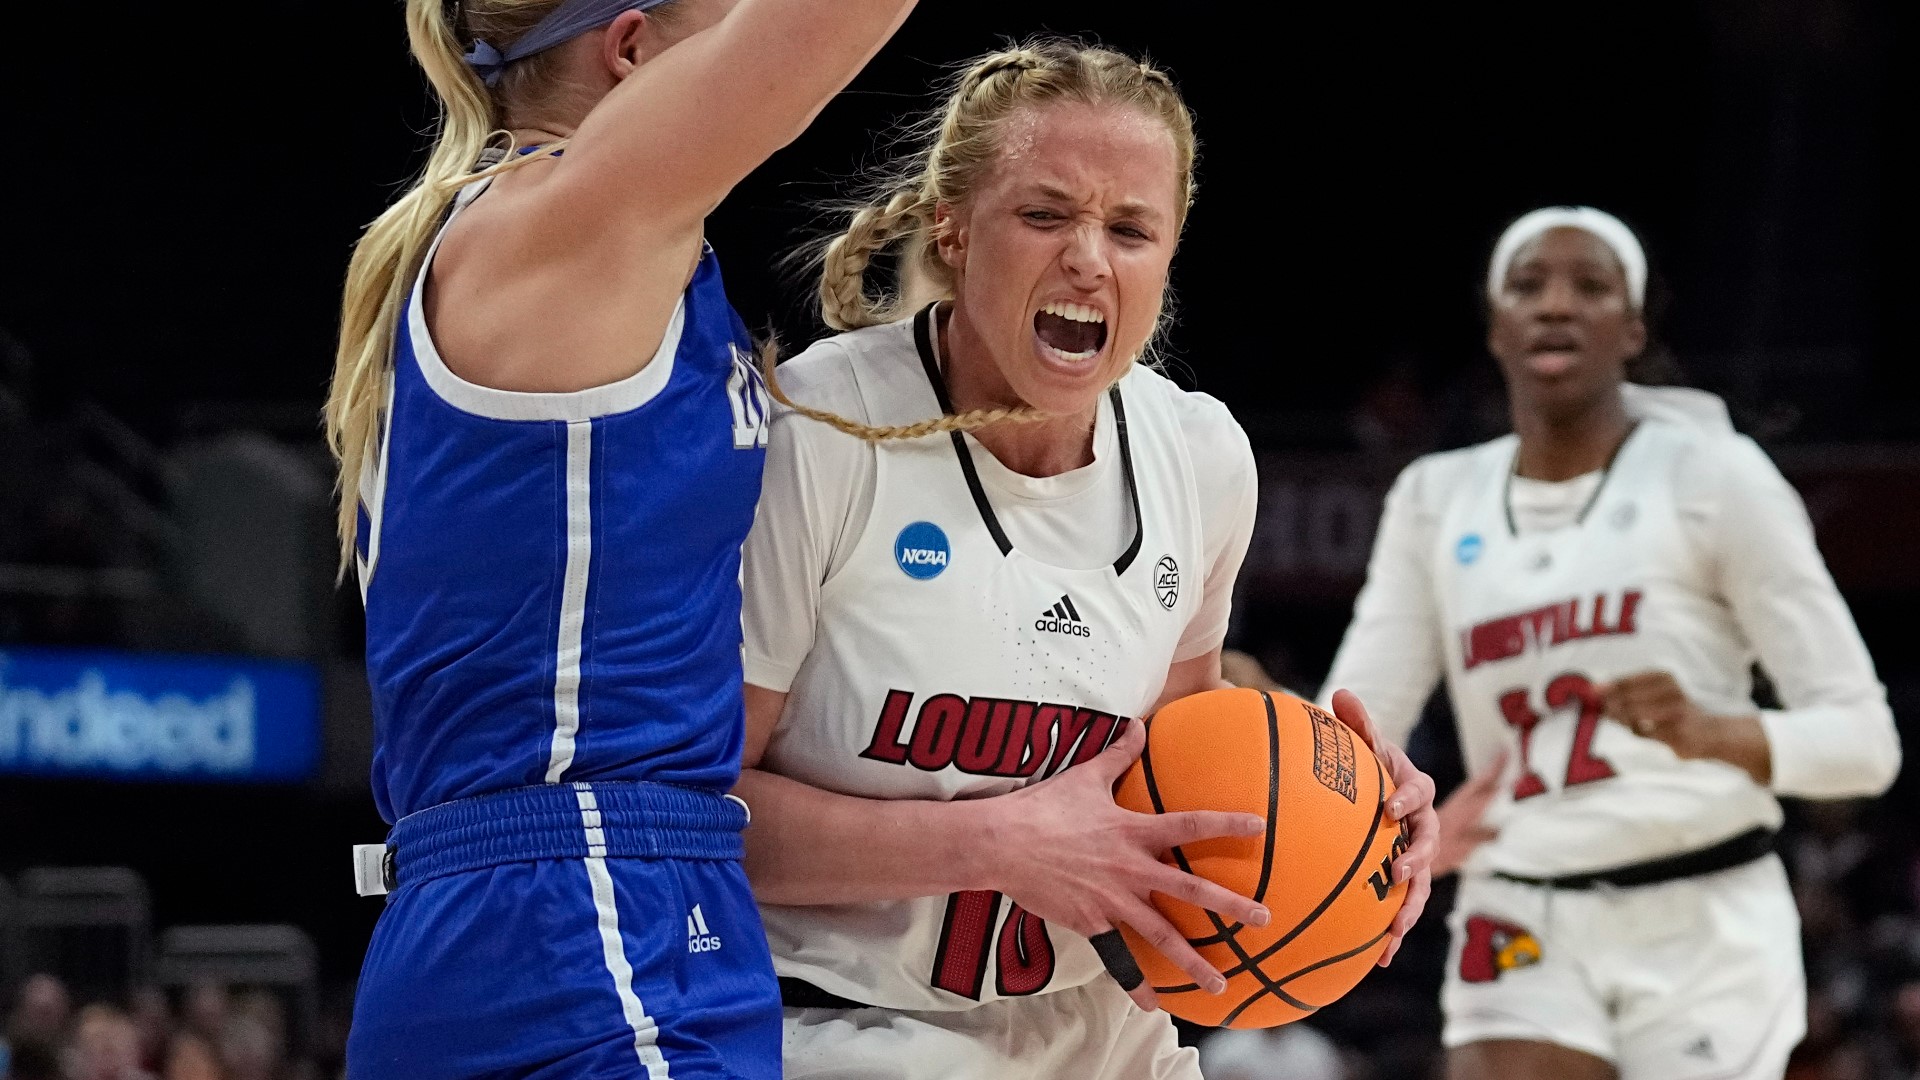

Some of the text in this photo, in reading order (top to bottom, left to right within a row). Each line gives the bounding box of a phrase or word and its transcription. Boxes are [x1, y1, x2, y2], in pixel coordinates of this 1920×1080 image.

[902, 547, 947, 566] NCAA
[1158, 573, 1179, 586] ACC
[1035, 618, 1091, 638] adidas
[0, 662, 256, 772] ndeed
